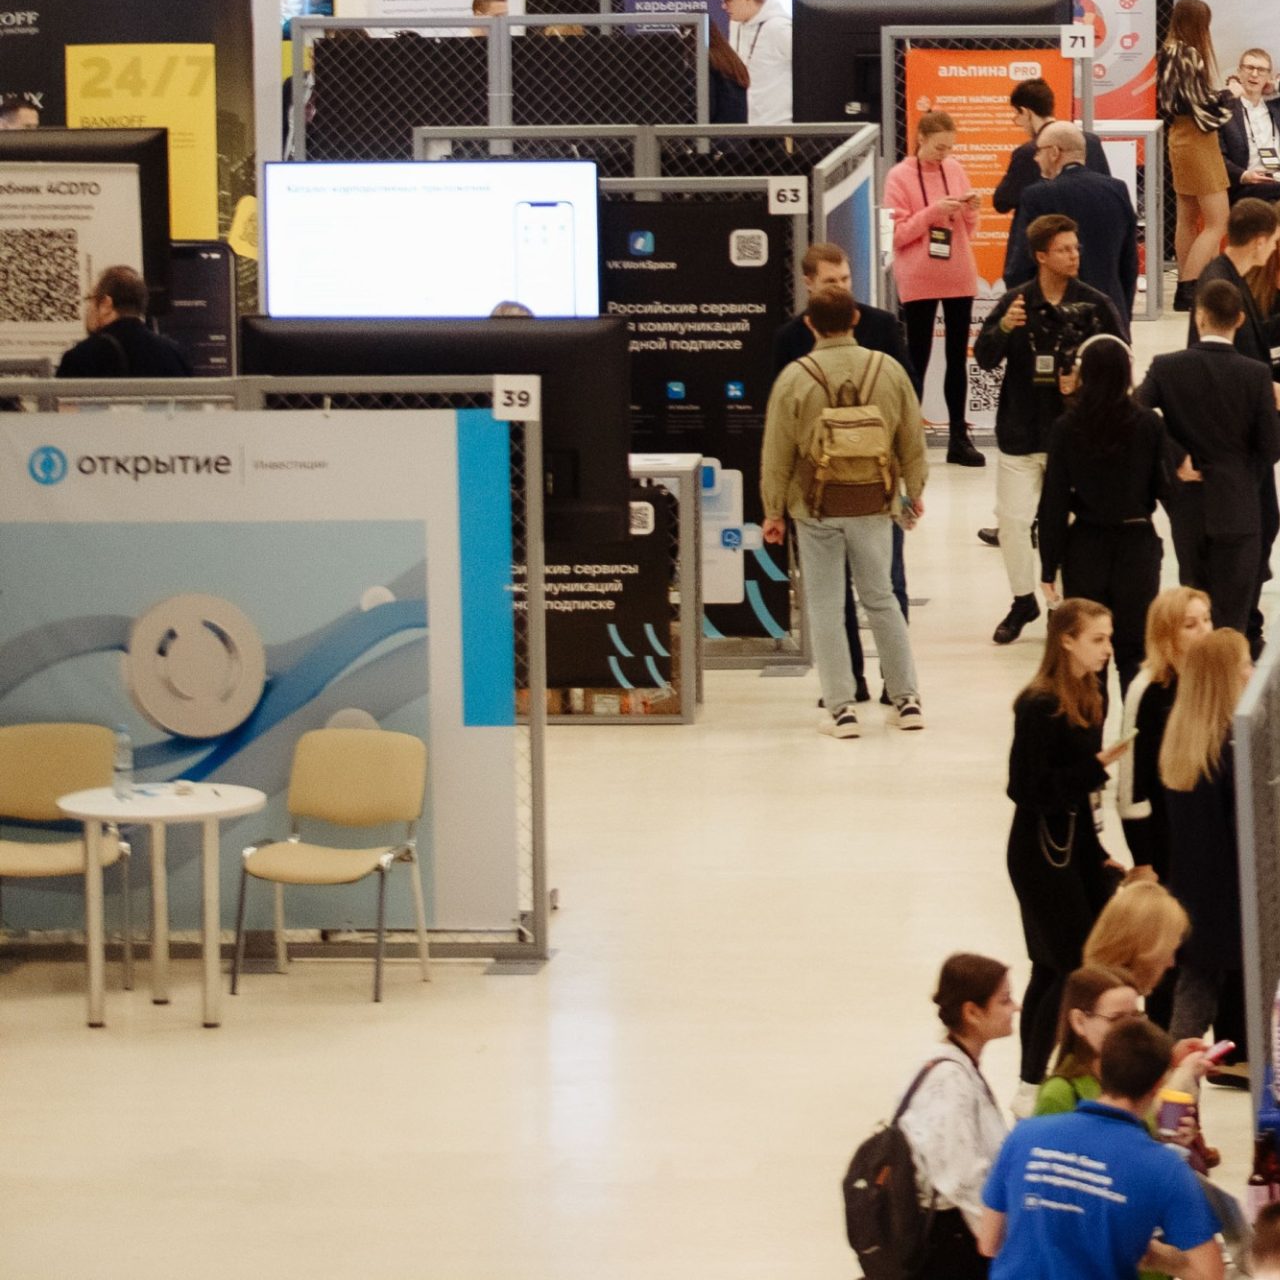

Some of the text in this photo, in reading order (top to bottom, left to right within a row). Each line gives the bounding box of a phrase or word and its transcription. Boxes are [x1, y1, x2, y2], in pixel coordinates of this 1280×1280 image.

[635, 0, 708, 13] карьерная
[1069, 36, 1087, 48] 71
[79, 55, 212, 100] 24/7
[938, 65, 1037, 78] альпина PRO
[776, 189, 800, 203] 63
[622, 260, 678, 271] WorkSpace
[608, 301, 767, 317] Российские сервисы
[639, 320, 750, 335] коммуникаций
[670, 339, 743, 353] подписке
[502, 389, 530, 408] 39
[78, 451, 231, 480] открытие
[573, 563, 640, 577] сервисы
